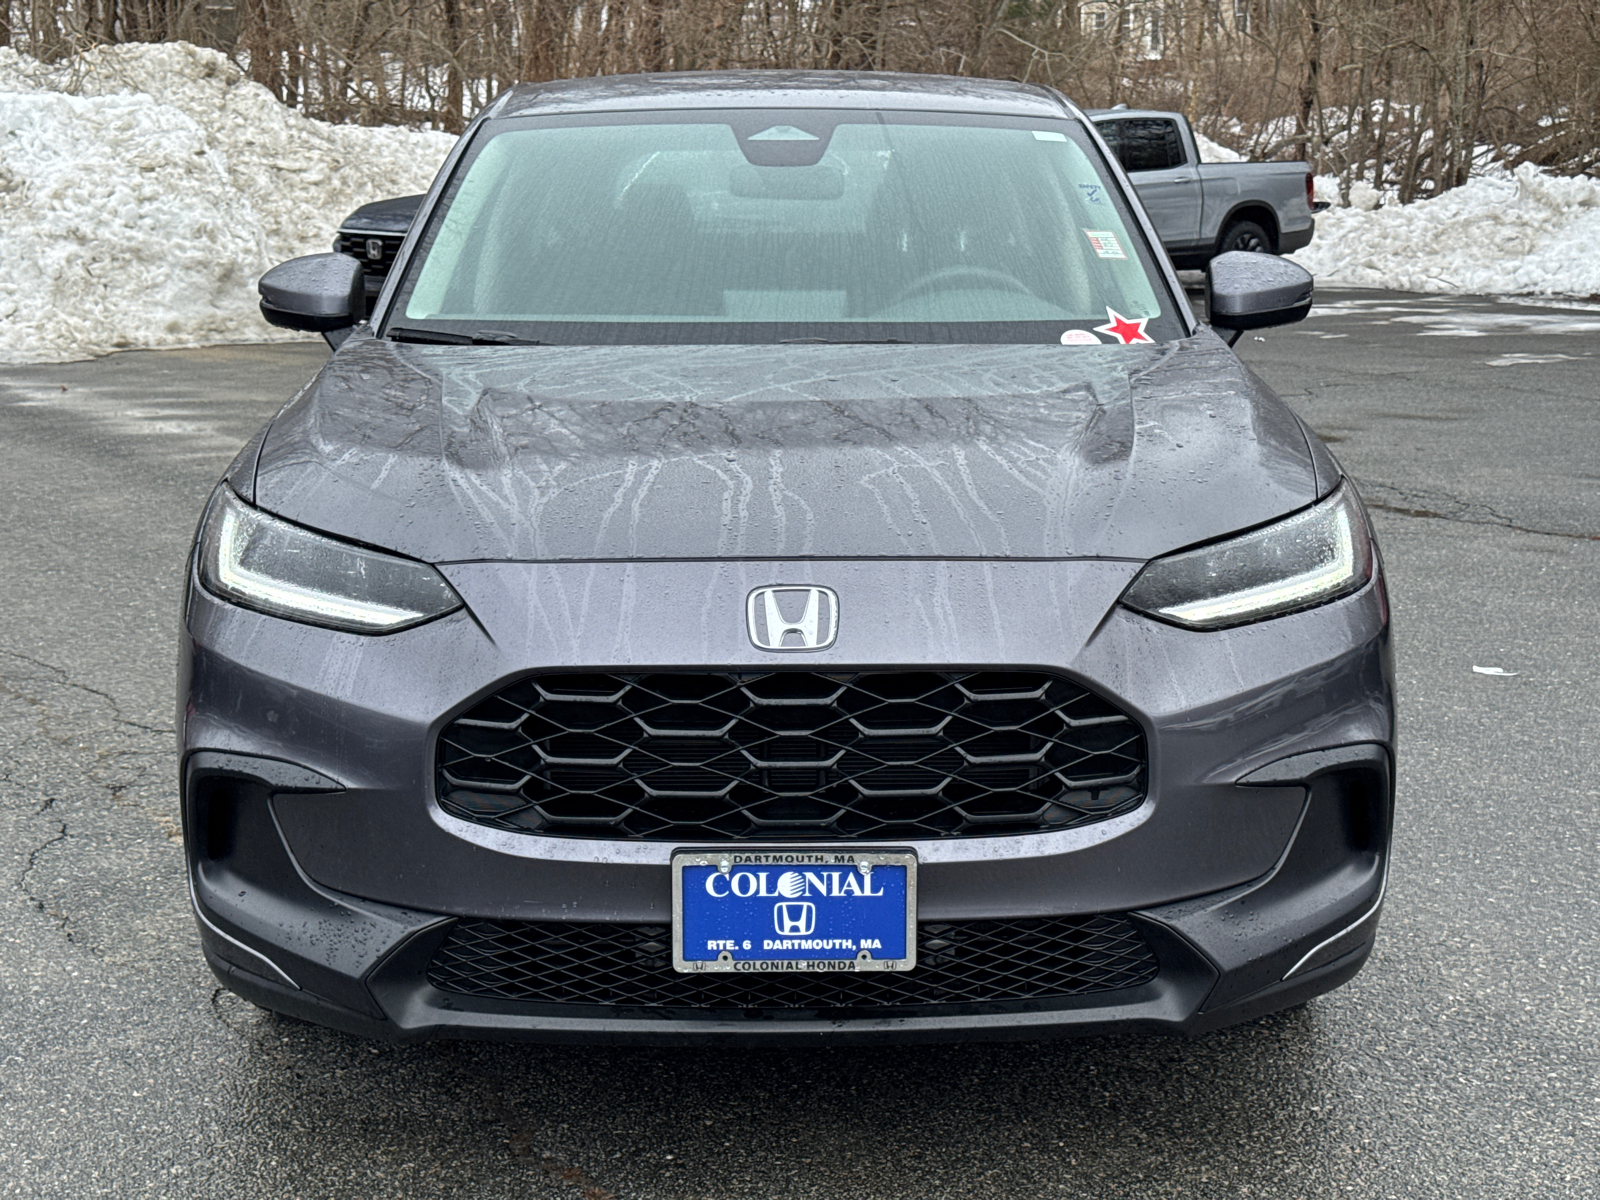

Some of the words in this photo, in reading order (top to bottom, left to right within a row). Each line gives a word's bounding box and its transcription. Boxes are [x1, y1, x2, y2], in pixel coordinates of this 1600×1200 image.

[734, 855, 829, 864] DARTMOUTH,
[834, 855, 855, 863] MA
[705, 871, 884, 898] COLONIAL
[707, 940, 739, 950] RTE.
[743, 940, 752, 950] 6
[763, 939, 857, 951] DARTMOUTH,
[860, 939, 882, 949] MA
[733, 961, 805, 971] COLONIAL
[806, 960, 856, 971] HONDA
